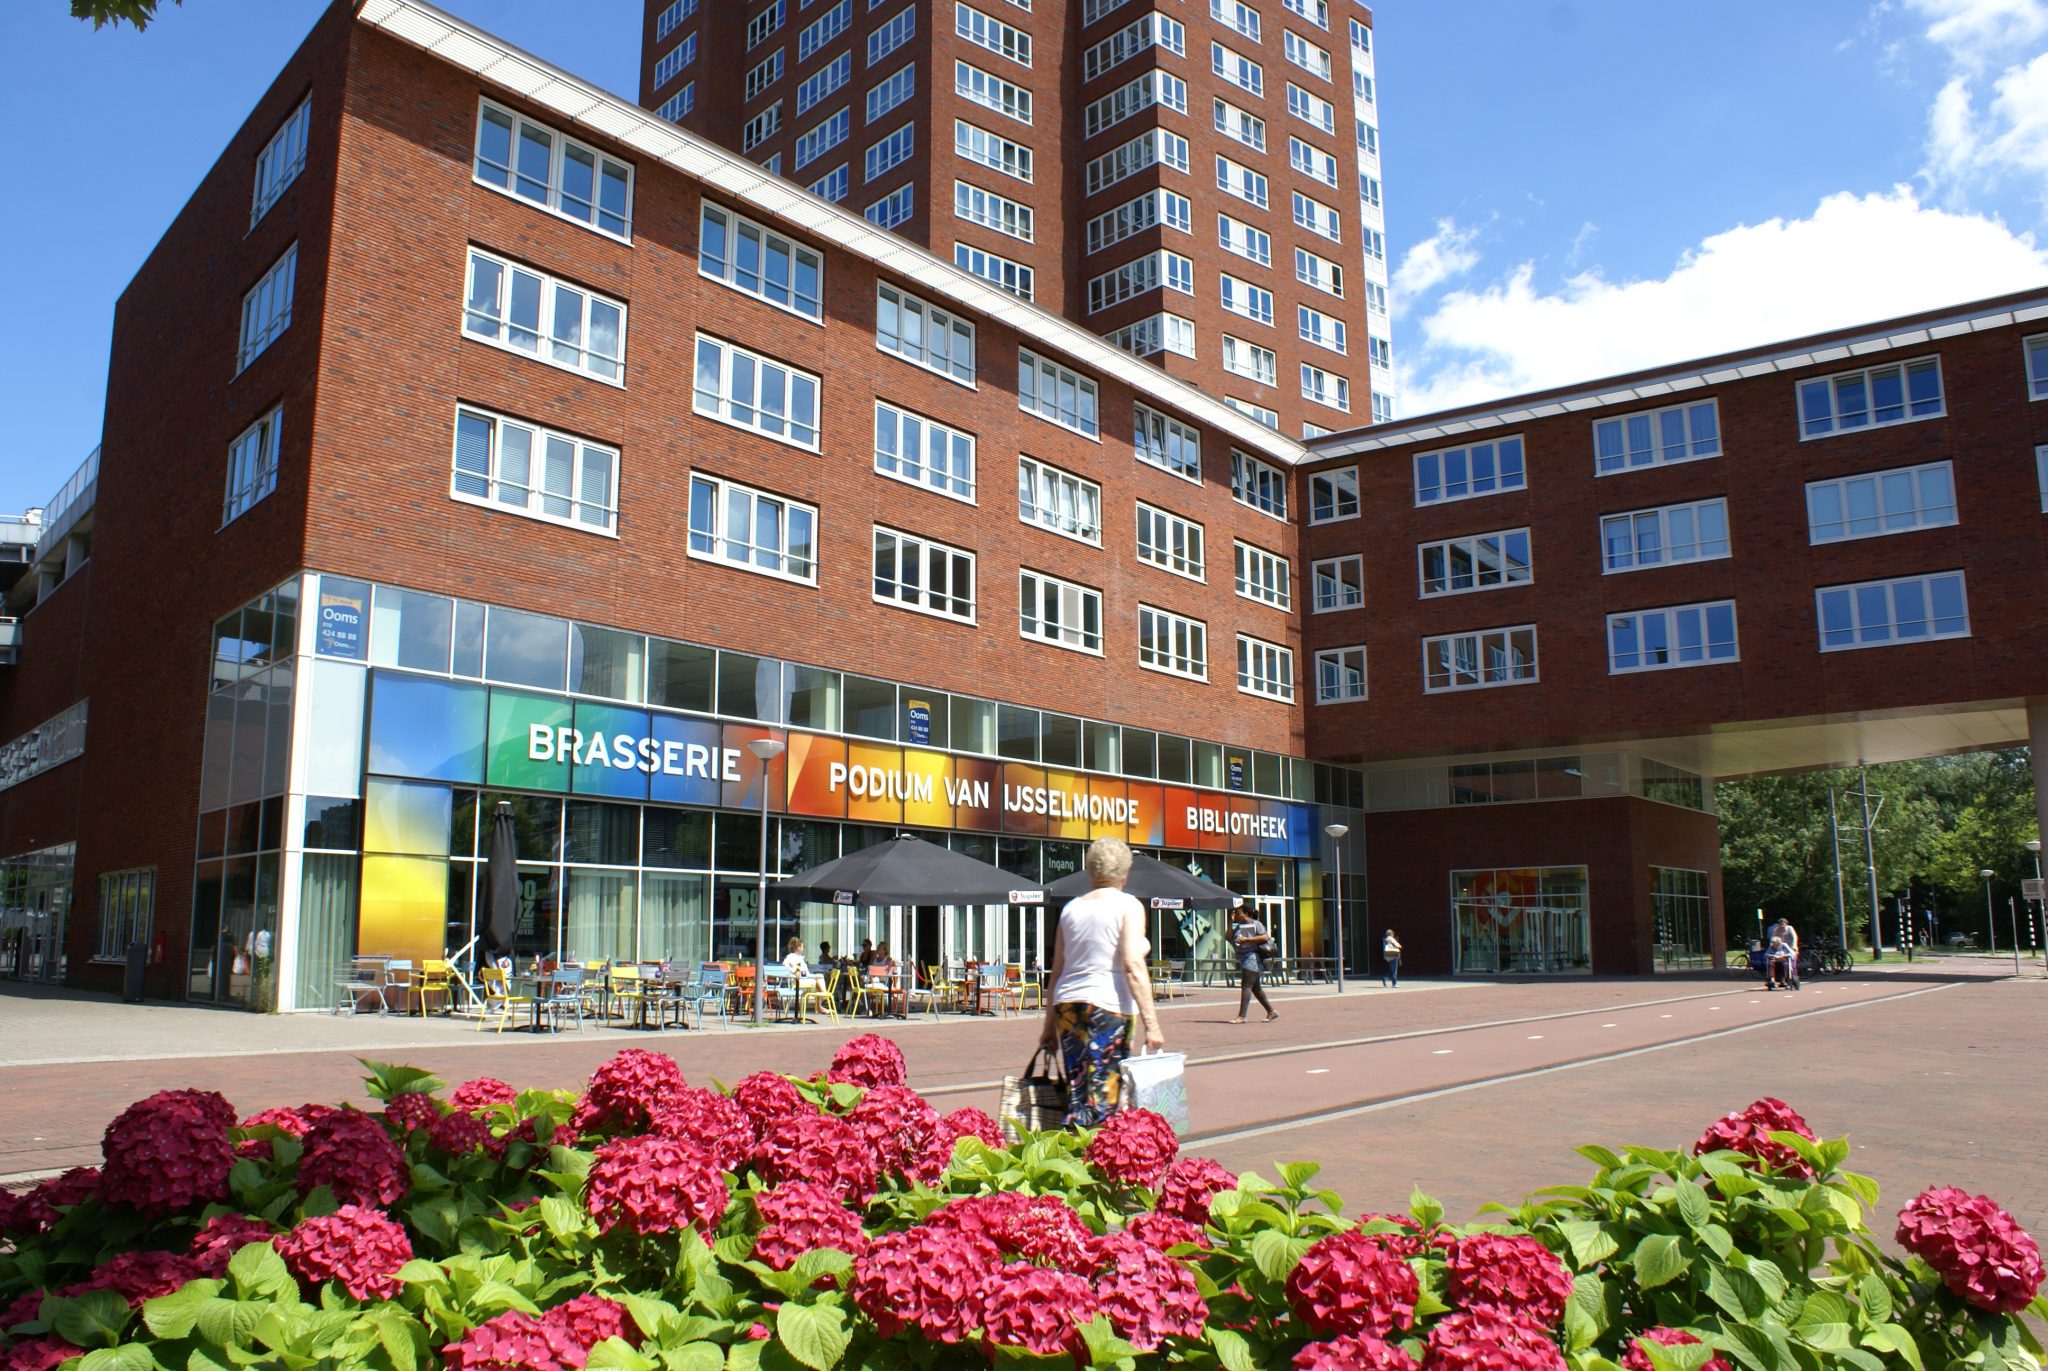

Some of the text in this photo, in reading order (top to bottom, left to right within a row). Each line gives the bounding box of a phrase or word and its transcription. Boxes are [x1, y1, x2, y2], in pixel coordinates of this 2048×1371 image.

[324, 608, 358, 624] Ooms
[911, 710, 928, 720] Ooms
[529, 723, 741, 782] BRASSERIE
[829, 762, 1139, 824] PODIUM VAN IJSSELMONDE
[1186, 807, 1287, 840] BIBLIOTHEEK
[1049, 857, 1074, 871] Ingang
[1161, 900, 1181, 908] Jupiler
